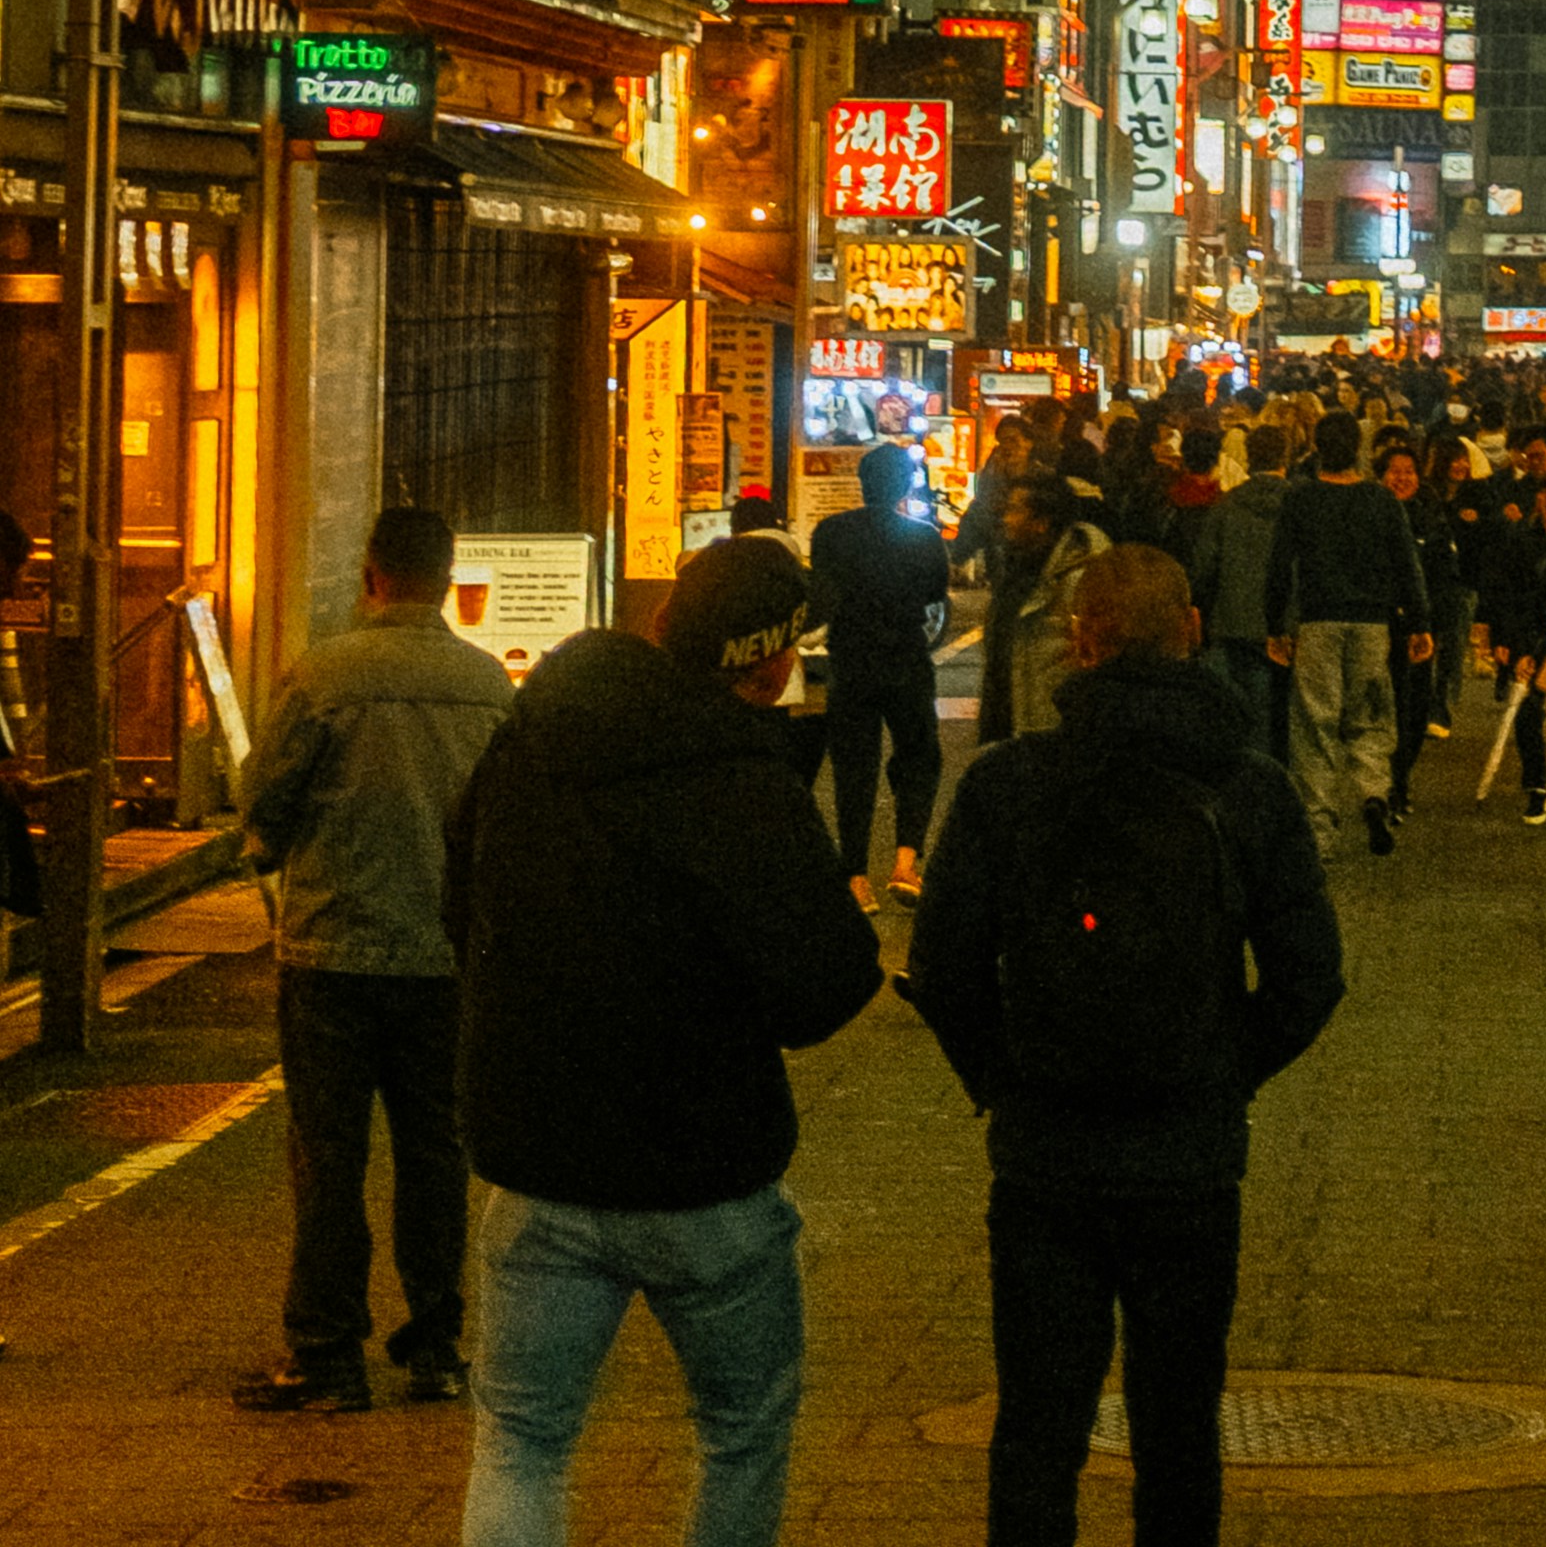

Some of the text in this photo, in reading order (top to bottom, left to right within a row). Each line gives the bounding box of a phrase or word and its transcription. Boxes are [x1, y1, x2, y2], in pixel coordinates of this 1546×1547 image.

[296, 72, 418, 105] Pizzeria
[834, 103, 941, 162] 湖南
[645, 425, 665, 507] やきとん
